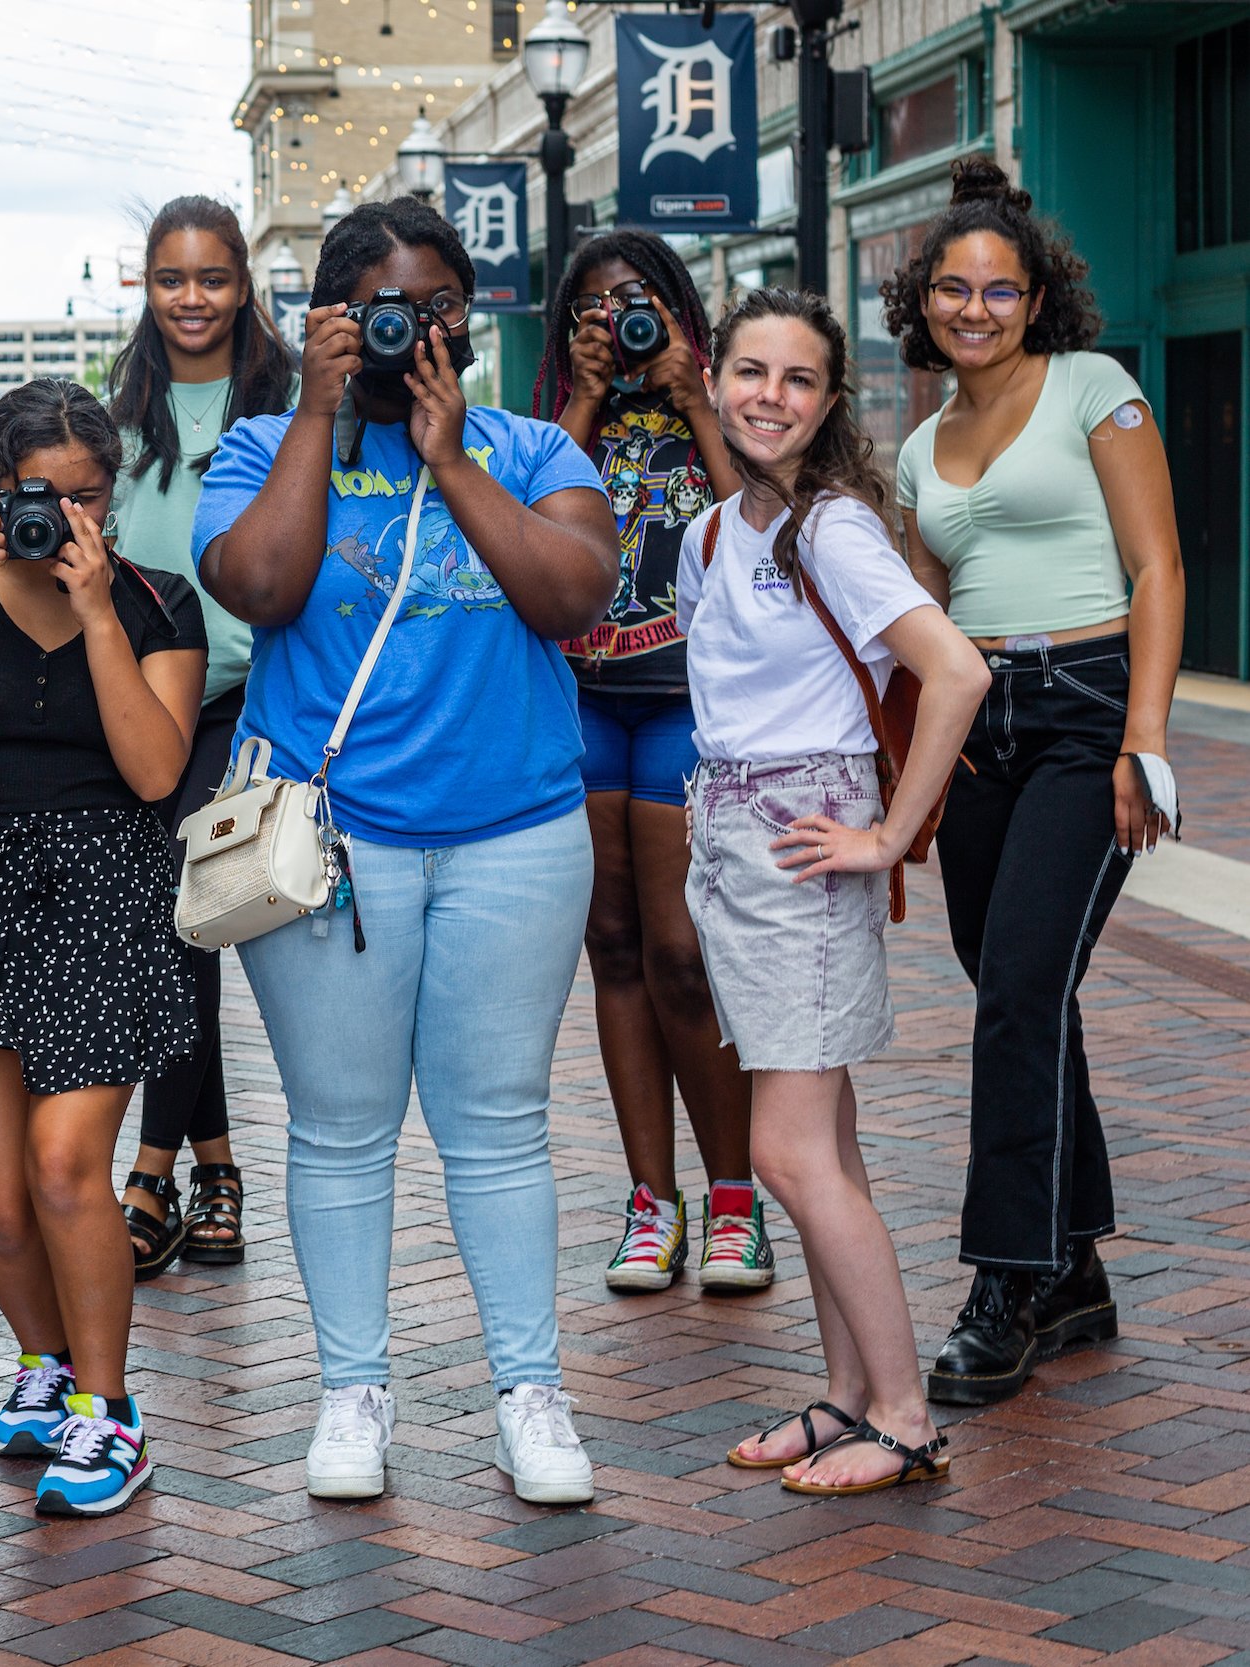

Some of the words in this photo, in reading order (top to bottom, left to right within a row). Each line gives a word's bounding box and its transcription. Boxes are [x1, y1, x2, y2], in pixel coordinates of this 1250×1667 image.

[637, 32, 737, 175] D
[452, 177, 521, 267] D
[378, 289, 401, 297] Canon
[616, 618, 679, 653] DESTRU
